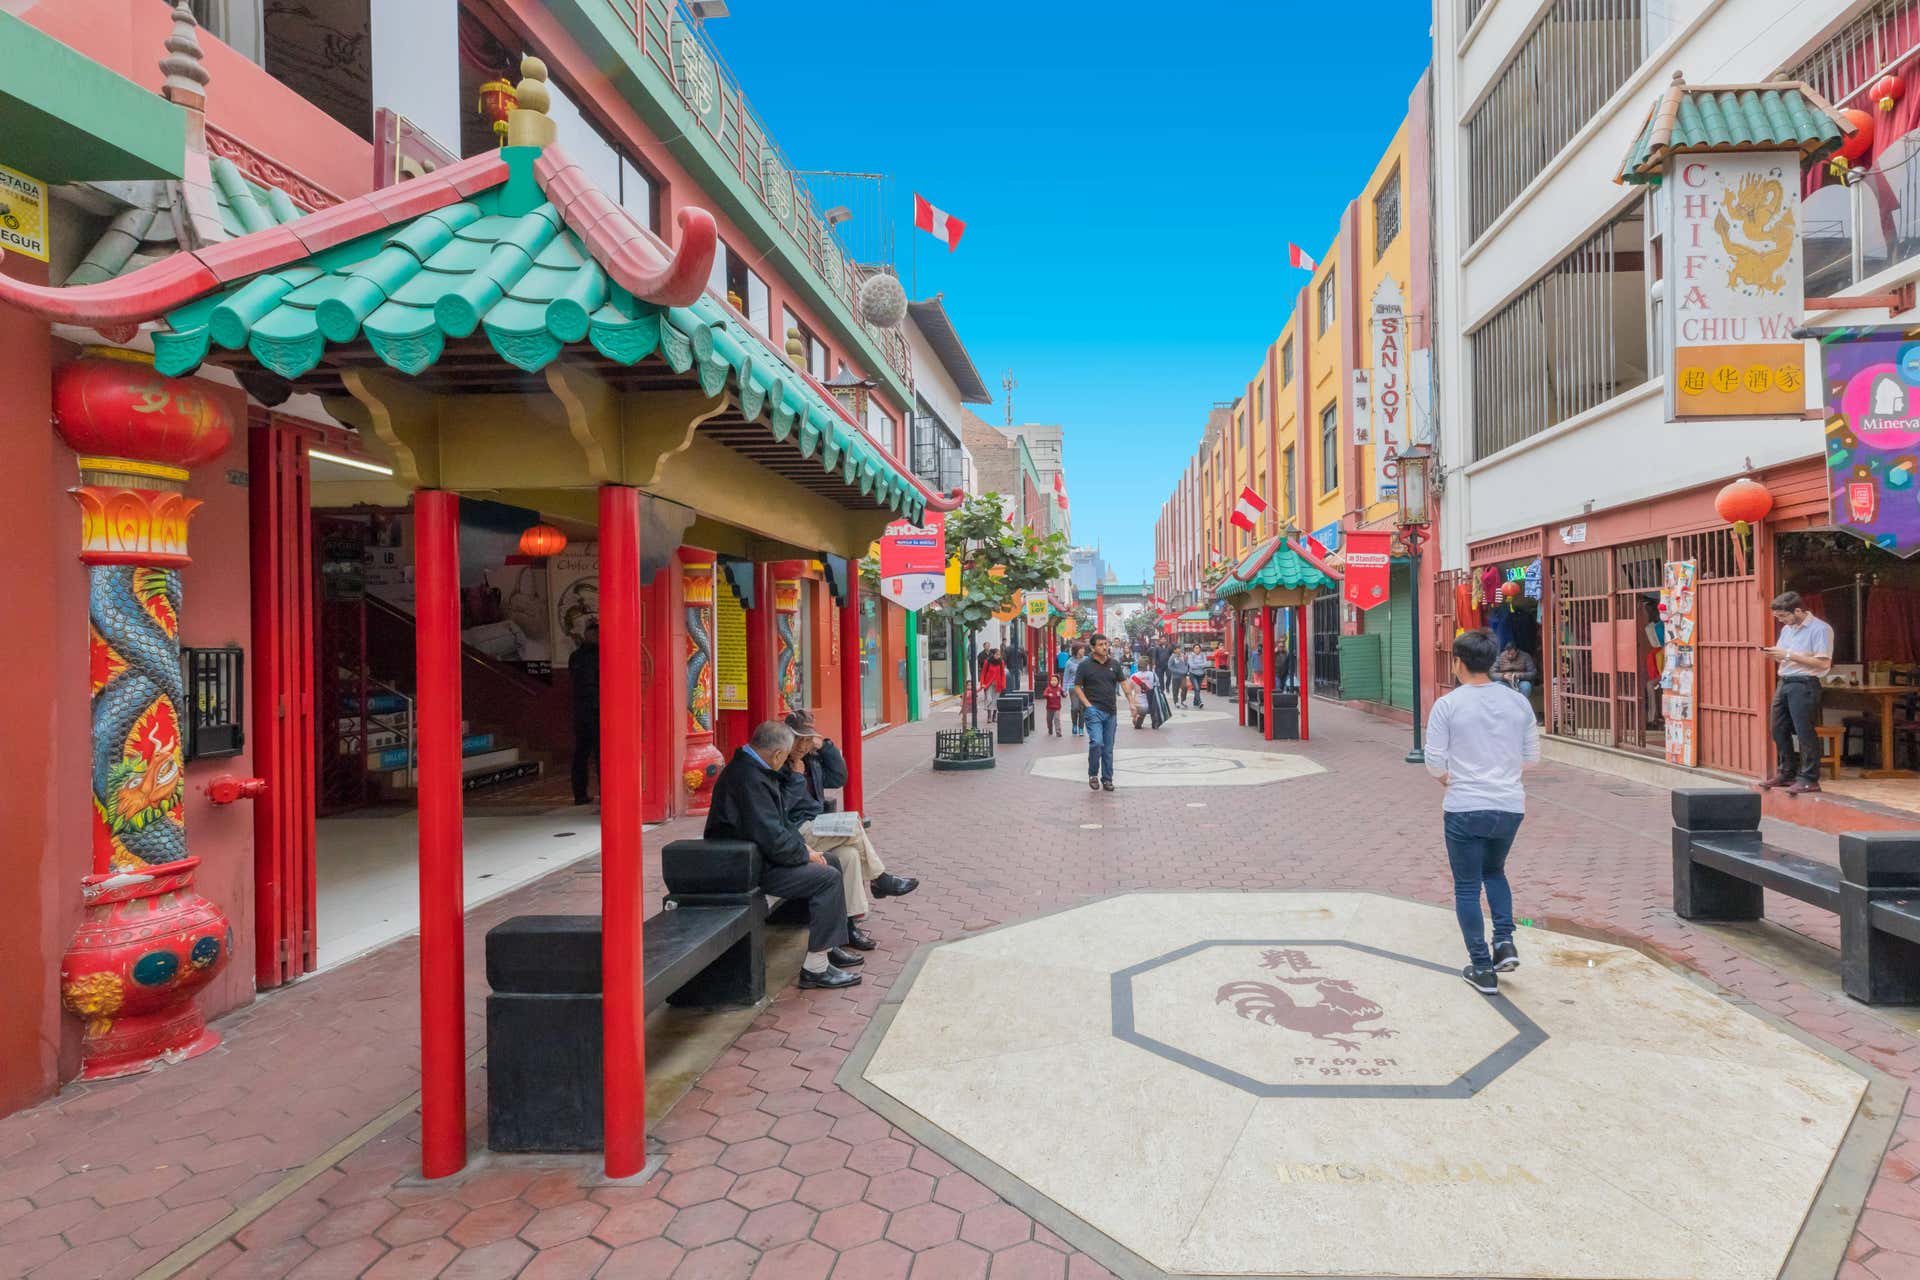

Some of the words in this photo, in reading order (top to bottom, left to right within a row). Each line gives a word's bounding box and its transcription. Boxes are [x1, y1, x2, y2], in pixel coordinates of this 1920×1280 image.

[1681, 163, 1710, 310] CHIFA
[1381, 317, 1398, 368] SAN
[1682, 317, 1748, 342] CHIU
[1380, 374, 1399, 424] JOY
[1863, 416, 1920, 431] Minerva
